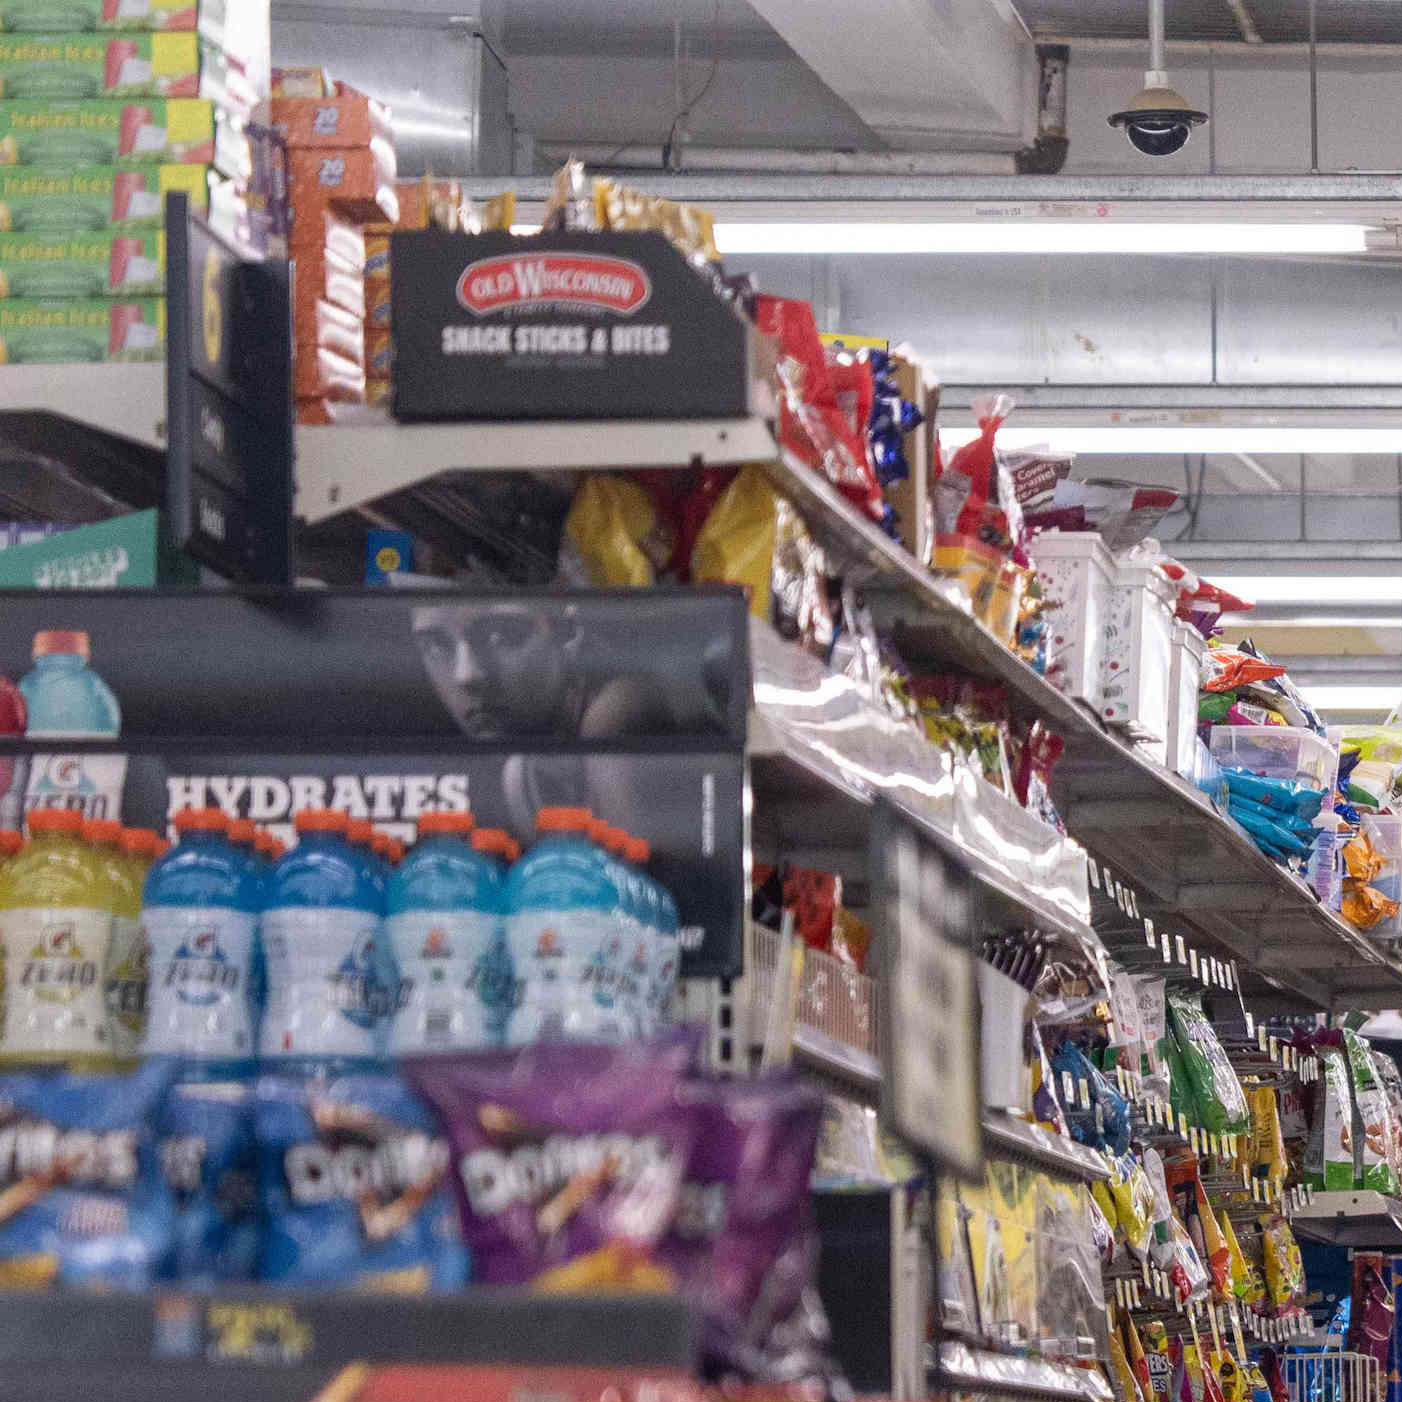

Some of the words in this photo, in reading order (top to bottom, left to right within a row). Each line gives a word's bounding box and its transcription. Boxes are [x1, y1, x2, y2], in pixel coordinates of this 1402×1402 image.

[442, 325, 512, 355] SNACK
[515, 325, 588, 355] STICKS
[612, 325, 672, 355] BITES
[166, 774, 470, 819] HYDRATES
